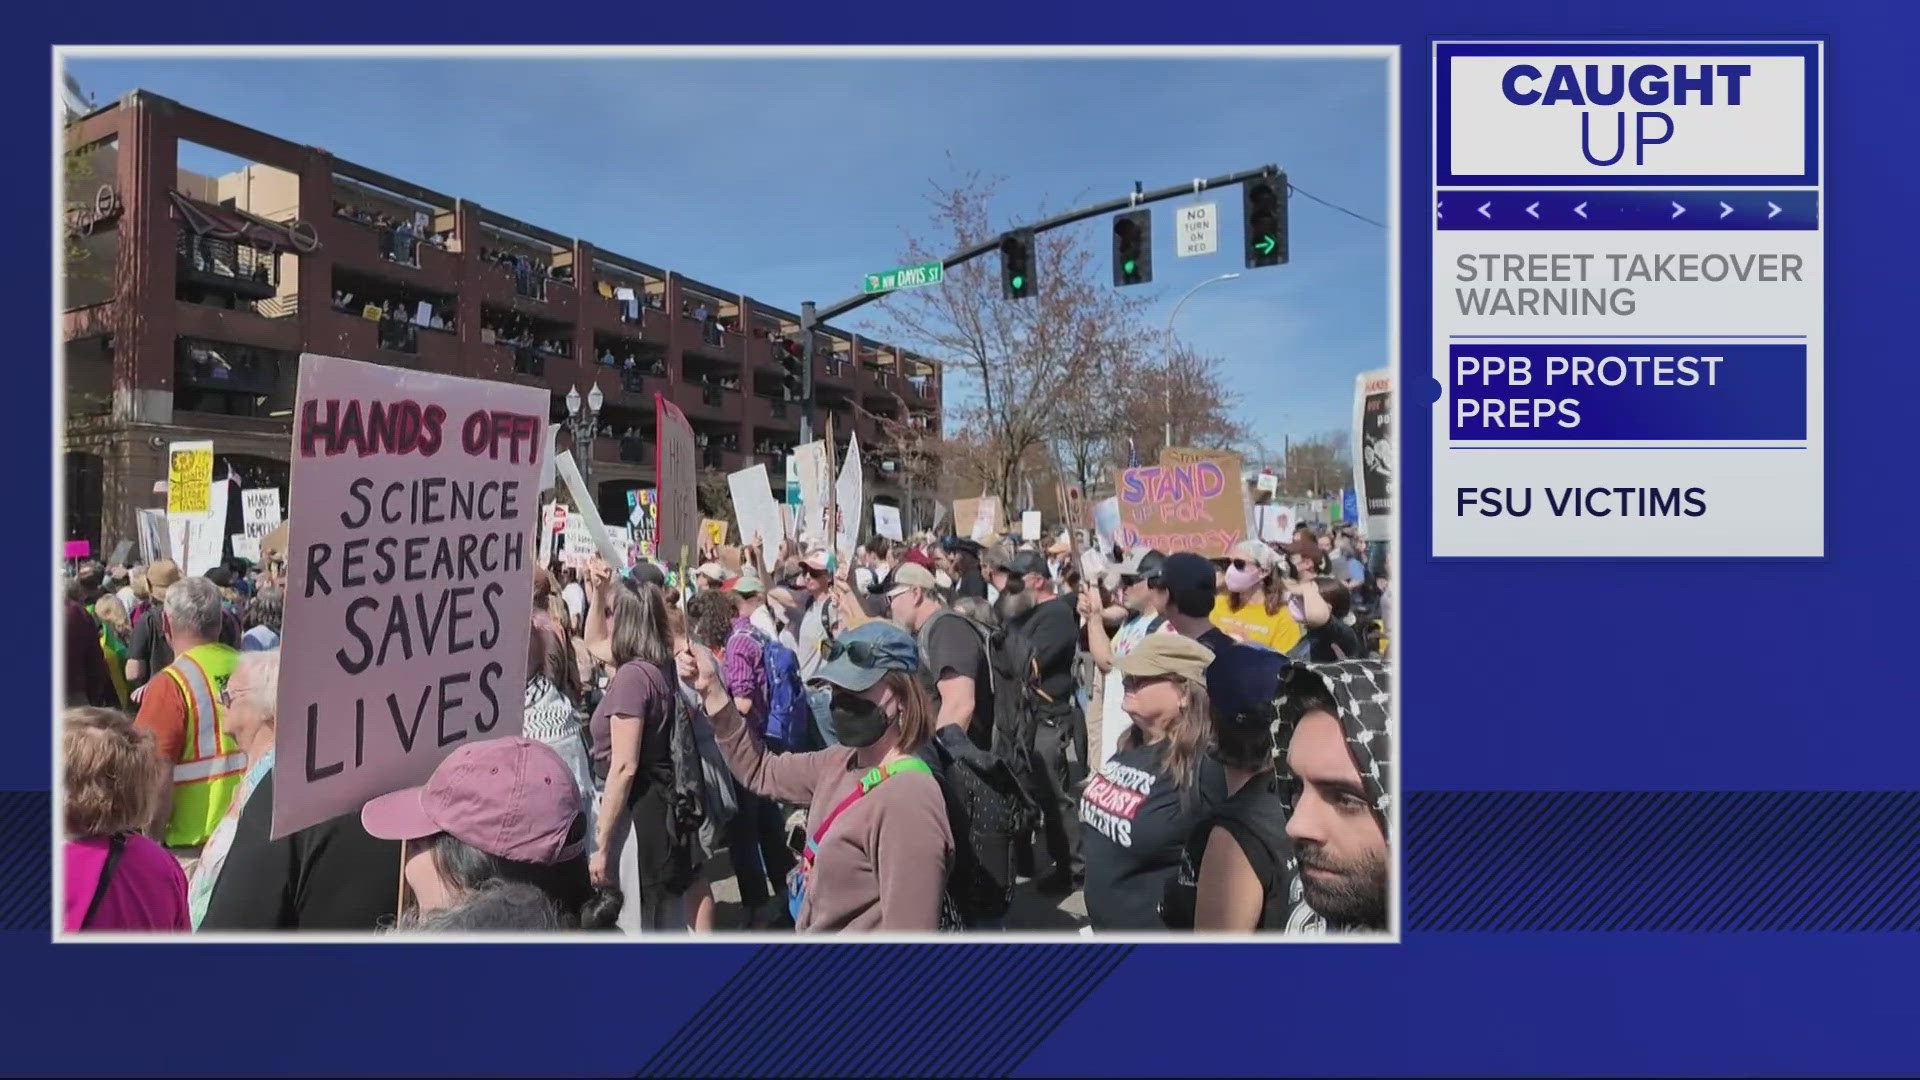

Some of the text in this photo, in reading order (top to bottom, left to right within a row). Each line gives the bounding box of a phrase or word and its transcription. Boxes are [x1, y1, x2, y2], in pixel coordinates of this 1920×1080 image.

[1185, 221, 1209, 232] TURN
[1187, 209, 1206, 220] NO
[1187, 243, 1206, 252] RED
[1190, 232, 1204, 242] ON
[882, 267, 939, 289] NW DAVIS ST
[300, 399, 446, 458] HANDS
[1122, 461, 1225, 504] STAND
[247, 493, 274, 508] HANDS
[340, 477, 520, 529] SCIENCE
[1160, 500, 1213, 524] FOR
[305, 532, 523, 598] RESEARCH
[336, 582, 504, 675] SAVES
[305, 661, 503, 783] LIVES
